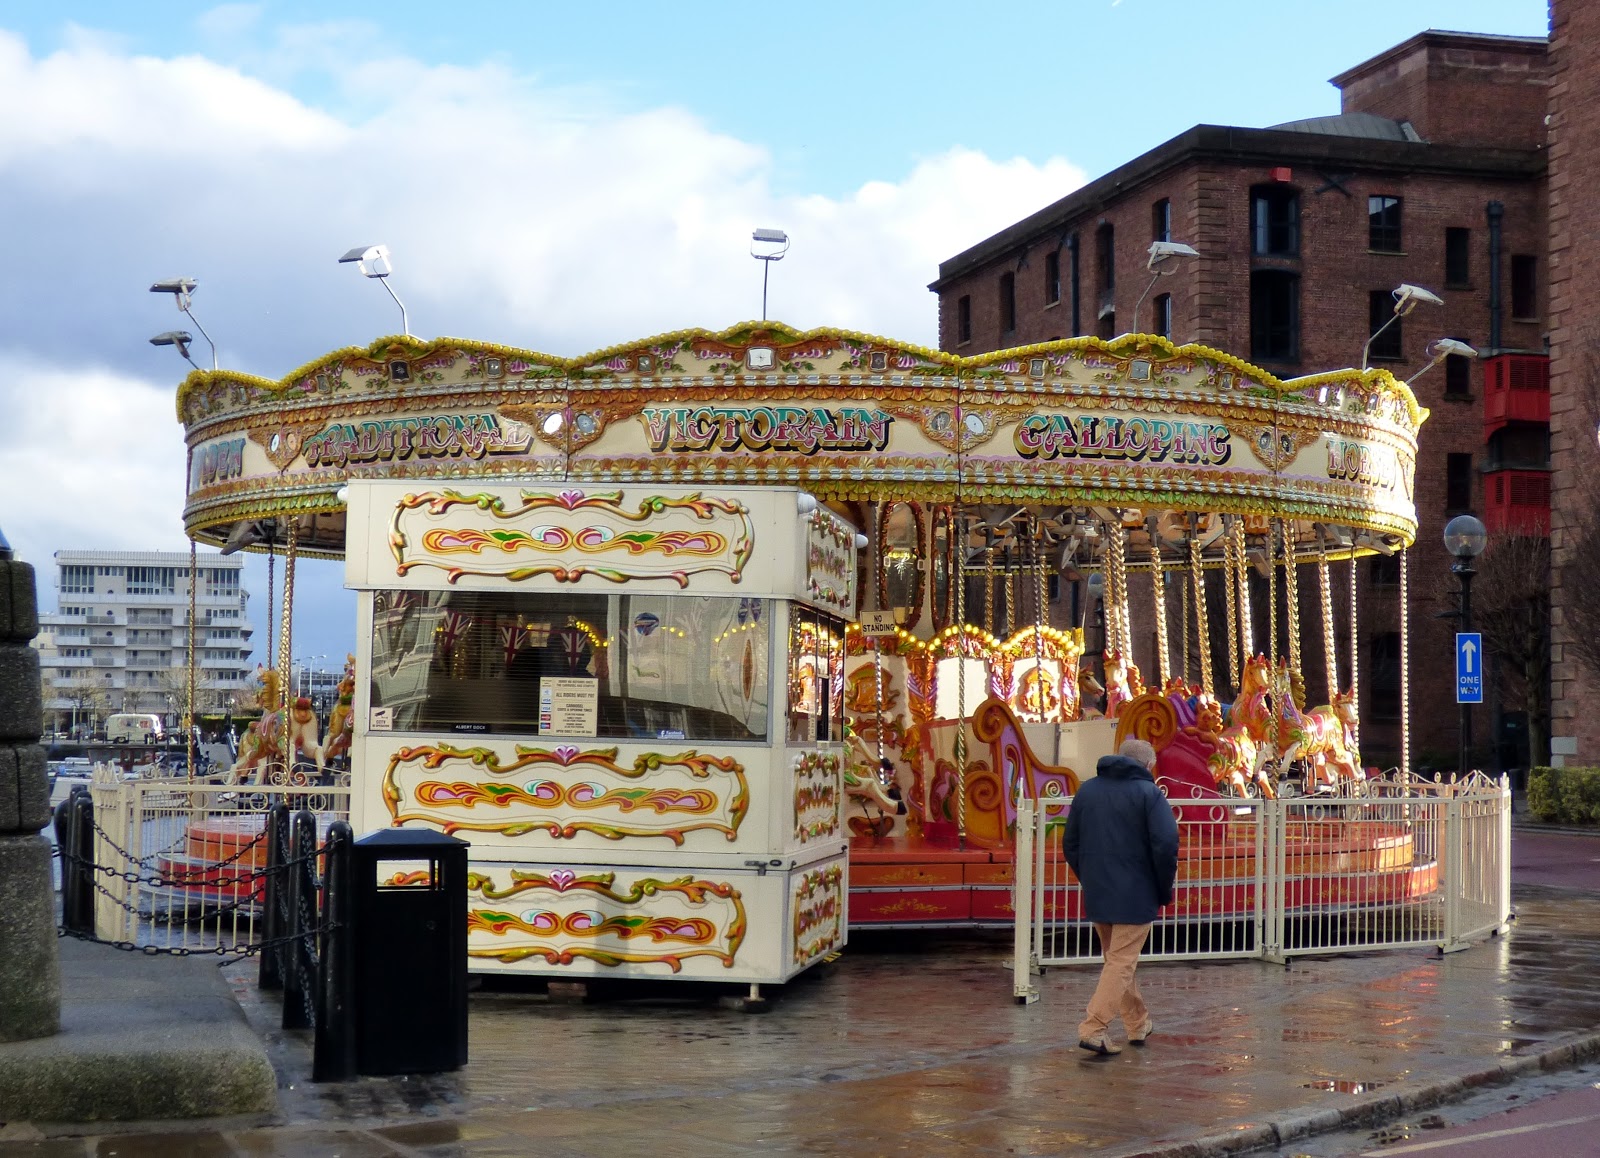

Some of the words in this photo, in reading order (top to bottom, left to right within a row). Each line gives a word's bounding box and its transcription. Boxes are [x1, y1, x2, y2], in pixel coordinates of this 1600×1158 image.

[303, 413, 534, 468] TRADITIONAL
[638, 406, 894, 455] VICTORAIN
[1013, 414, 1231, 465] GALLOPING
[1326, 439, 1396, 492] HOR
[863, 624, 894, 632] STANDING
[1460, 676, 1480, 684] ONE
